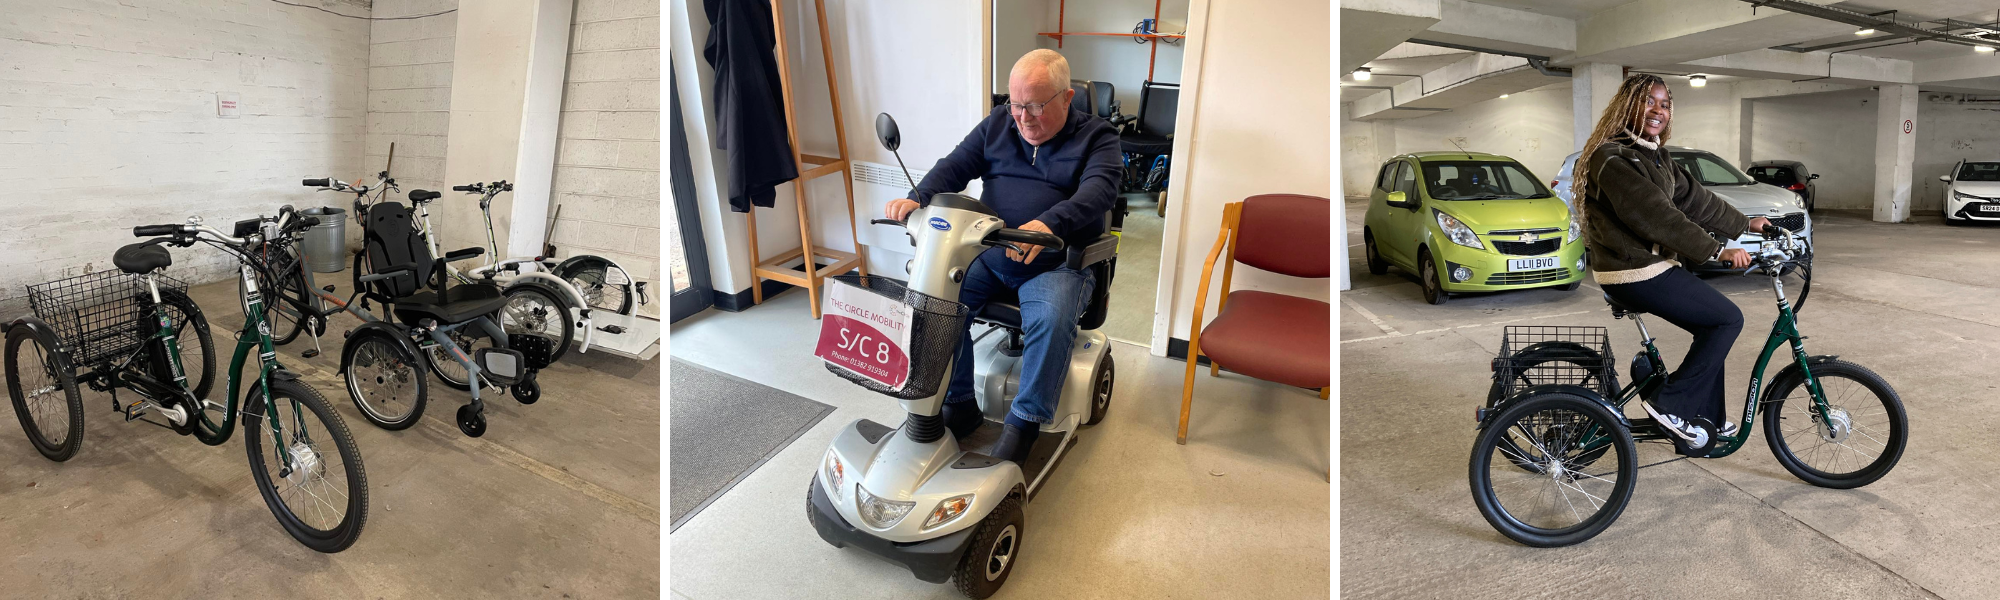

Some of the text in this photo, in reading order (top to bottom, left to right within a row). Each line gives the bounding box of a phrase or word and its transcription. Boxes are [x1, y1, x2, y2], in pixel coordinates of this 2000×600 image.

[831, 298, 843, 310] THE
[844, 304, 869, 318] CIRCLE
[871, 313, 906, 331] MOBILITY
[837, 327, 890, 364] S/C 8
[831, 351, 888, 377] Phone: 01382 919304
